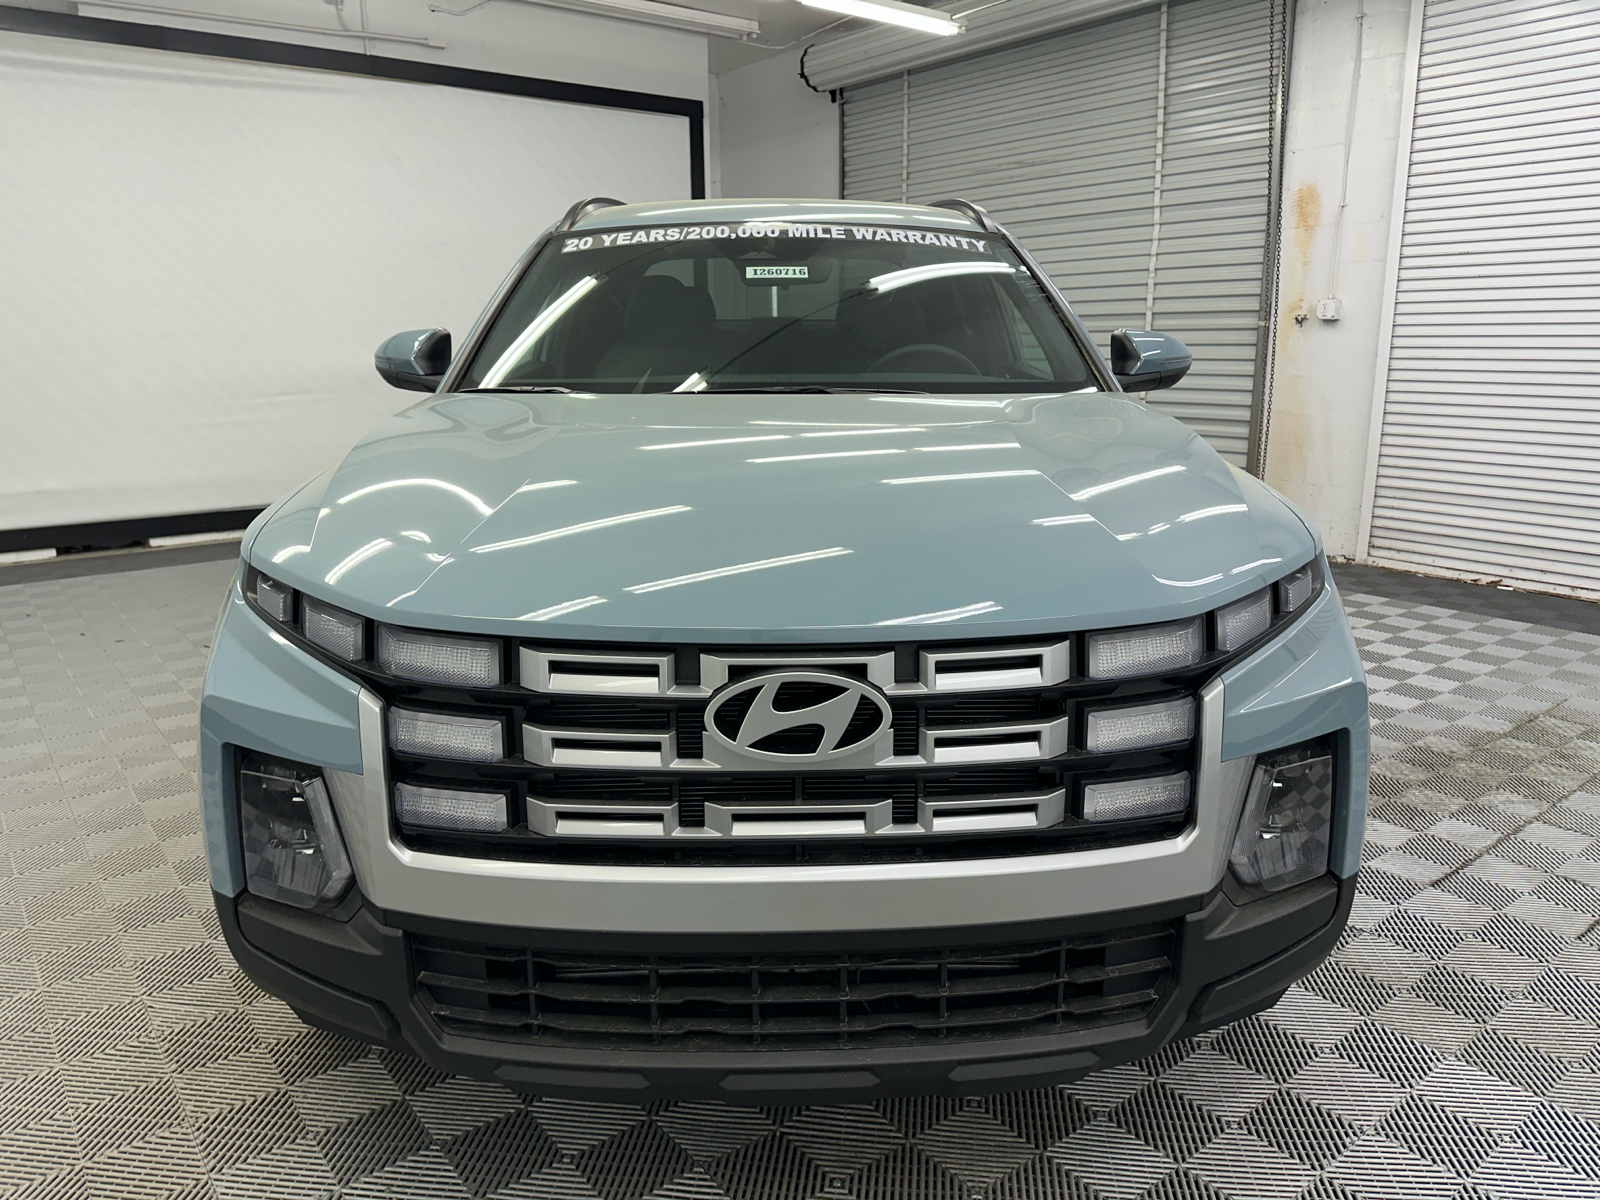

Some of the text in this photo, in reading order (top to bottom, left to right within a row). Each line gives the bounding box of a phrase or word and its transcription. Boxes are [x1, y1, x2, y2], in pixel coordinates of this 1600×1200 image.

[564, 225, 986, 253] 20 YEARS/200,000 MILE WARRANTY
[752, 268, 807, 276] I260716
